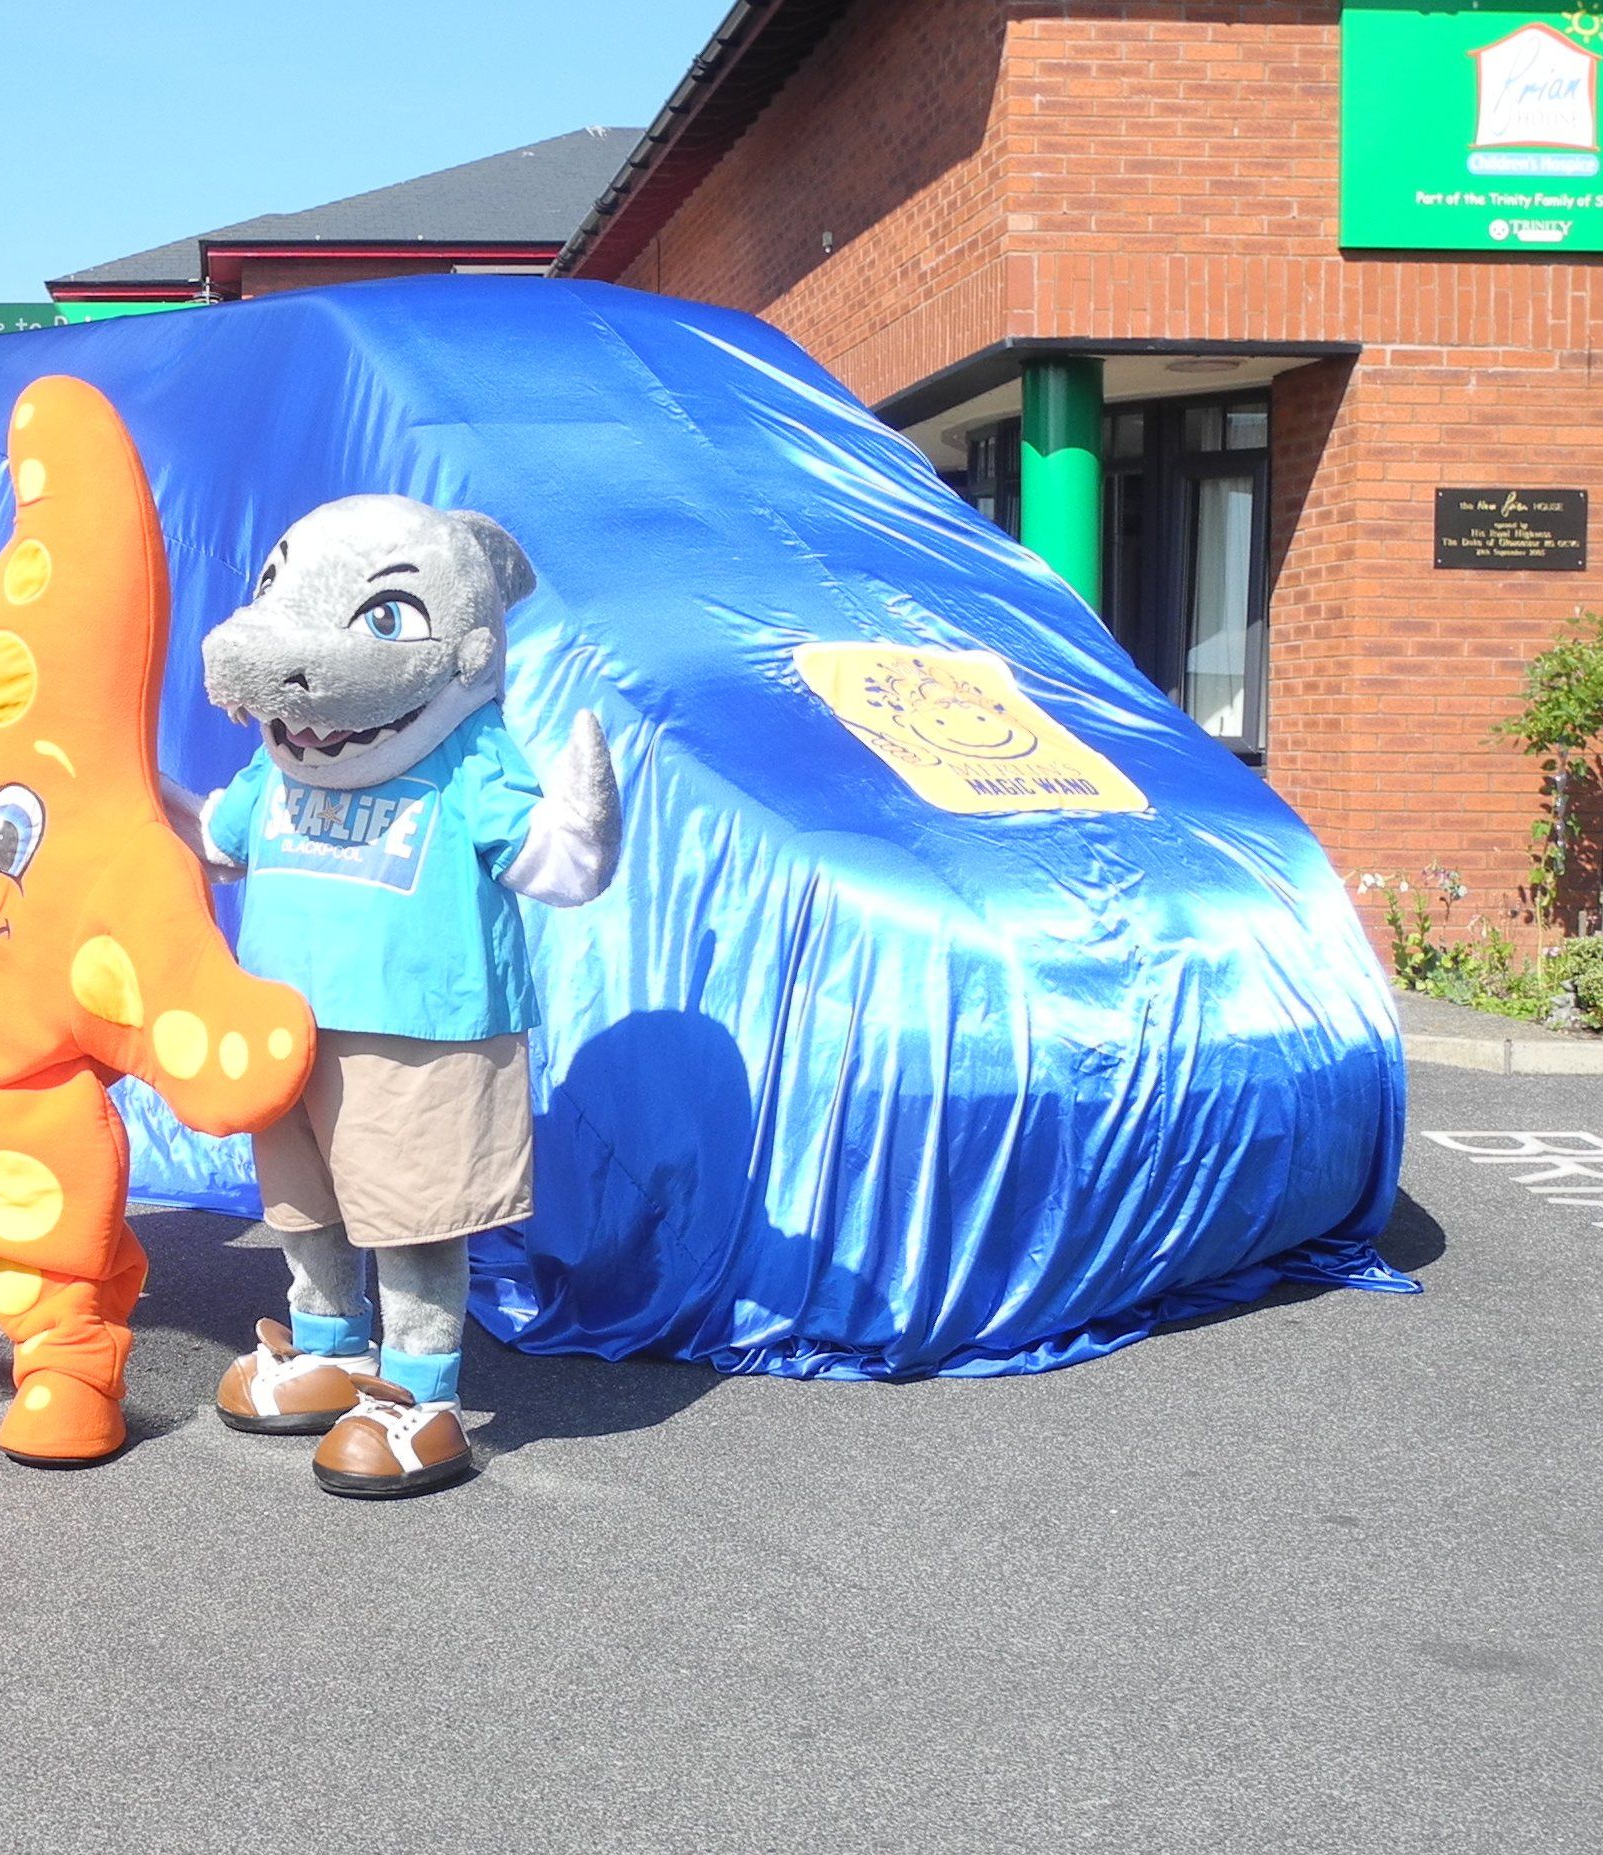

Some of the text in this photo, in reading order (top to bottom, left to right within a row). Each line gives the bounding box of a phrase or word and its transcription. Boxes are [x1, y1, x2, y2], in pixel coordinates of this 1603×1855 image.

[1415, 190, 1443, 205] Part
[1445, 191, 1461, 205] of
[1463, 192, 1486, 206] the
[1488, 192, 1532, 209] Trinity
[1534, 192, 1575, 210] Family
[1577, 193, 1592, 208] of
[1509, 220, 1573, 236] TRINITY
[264, 783, 327, 841] SEA
[280, 838, 363, 863] BLACKPOOL
